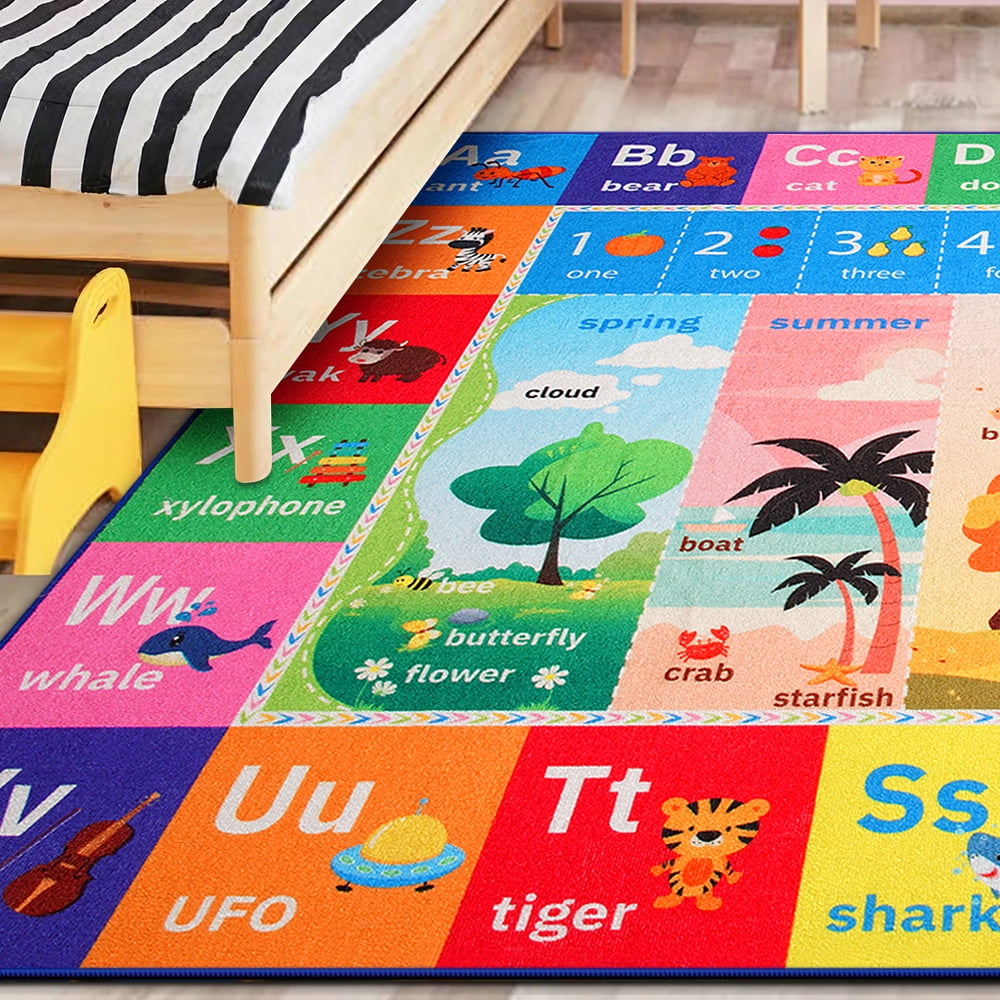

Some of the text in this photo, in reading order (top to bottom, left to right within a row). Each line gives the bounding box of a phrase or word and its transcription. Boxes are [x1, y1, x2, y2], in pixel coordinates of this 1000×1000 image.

[441, 145, 522, 166] Aa
[612, 144, 697, 166] Bb
[785, 144, 860, 166] Cc
[426, 181, 483, 192] ant
[601, 180, 679, 192] bear
[786, 180, 838, 191] cat
[382, 220, 463, 245] Zz
[957, 231, 995, 255] 4
[572, 232, 592, 256] 1
[694, 231, 733, 256] 2
[828, 231, 862, 256] 3
[566, 268, 619, 279] one
[710, 268, 761, 279] two
[841, 266, 906, 279] three
[578, 312, 701, 333] spring
[769, 315, 929, 330] summer
[284, 366, 344, 382] ak
[524, 385, 601, 400] cloud
[153, 495, 346, 521] xylophone
[679, 536, 744, 552] boat
[437, 580, 495, 594] bee
[65, 575, 215, 626] Ww
[445, 628, 586, 651] butterfly
[19, 663, 163, 691] whale
[405, 664, 516, 684] flower
[664, 663, 734, 682] crab
[773, 687, 893, 708] starfish
[215, 765, 375, 834] Uu
[544, 765, 652, 834] Tt
[857, 764, 989, 834] Ss
[164, 895, 298, 932] UFO
[492, 893, 637, 942] tiger
